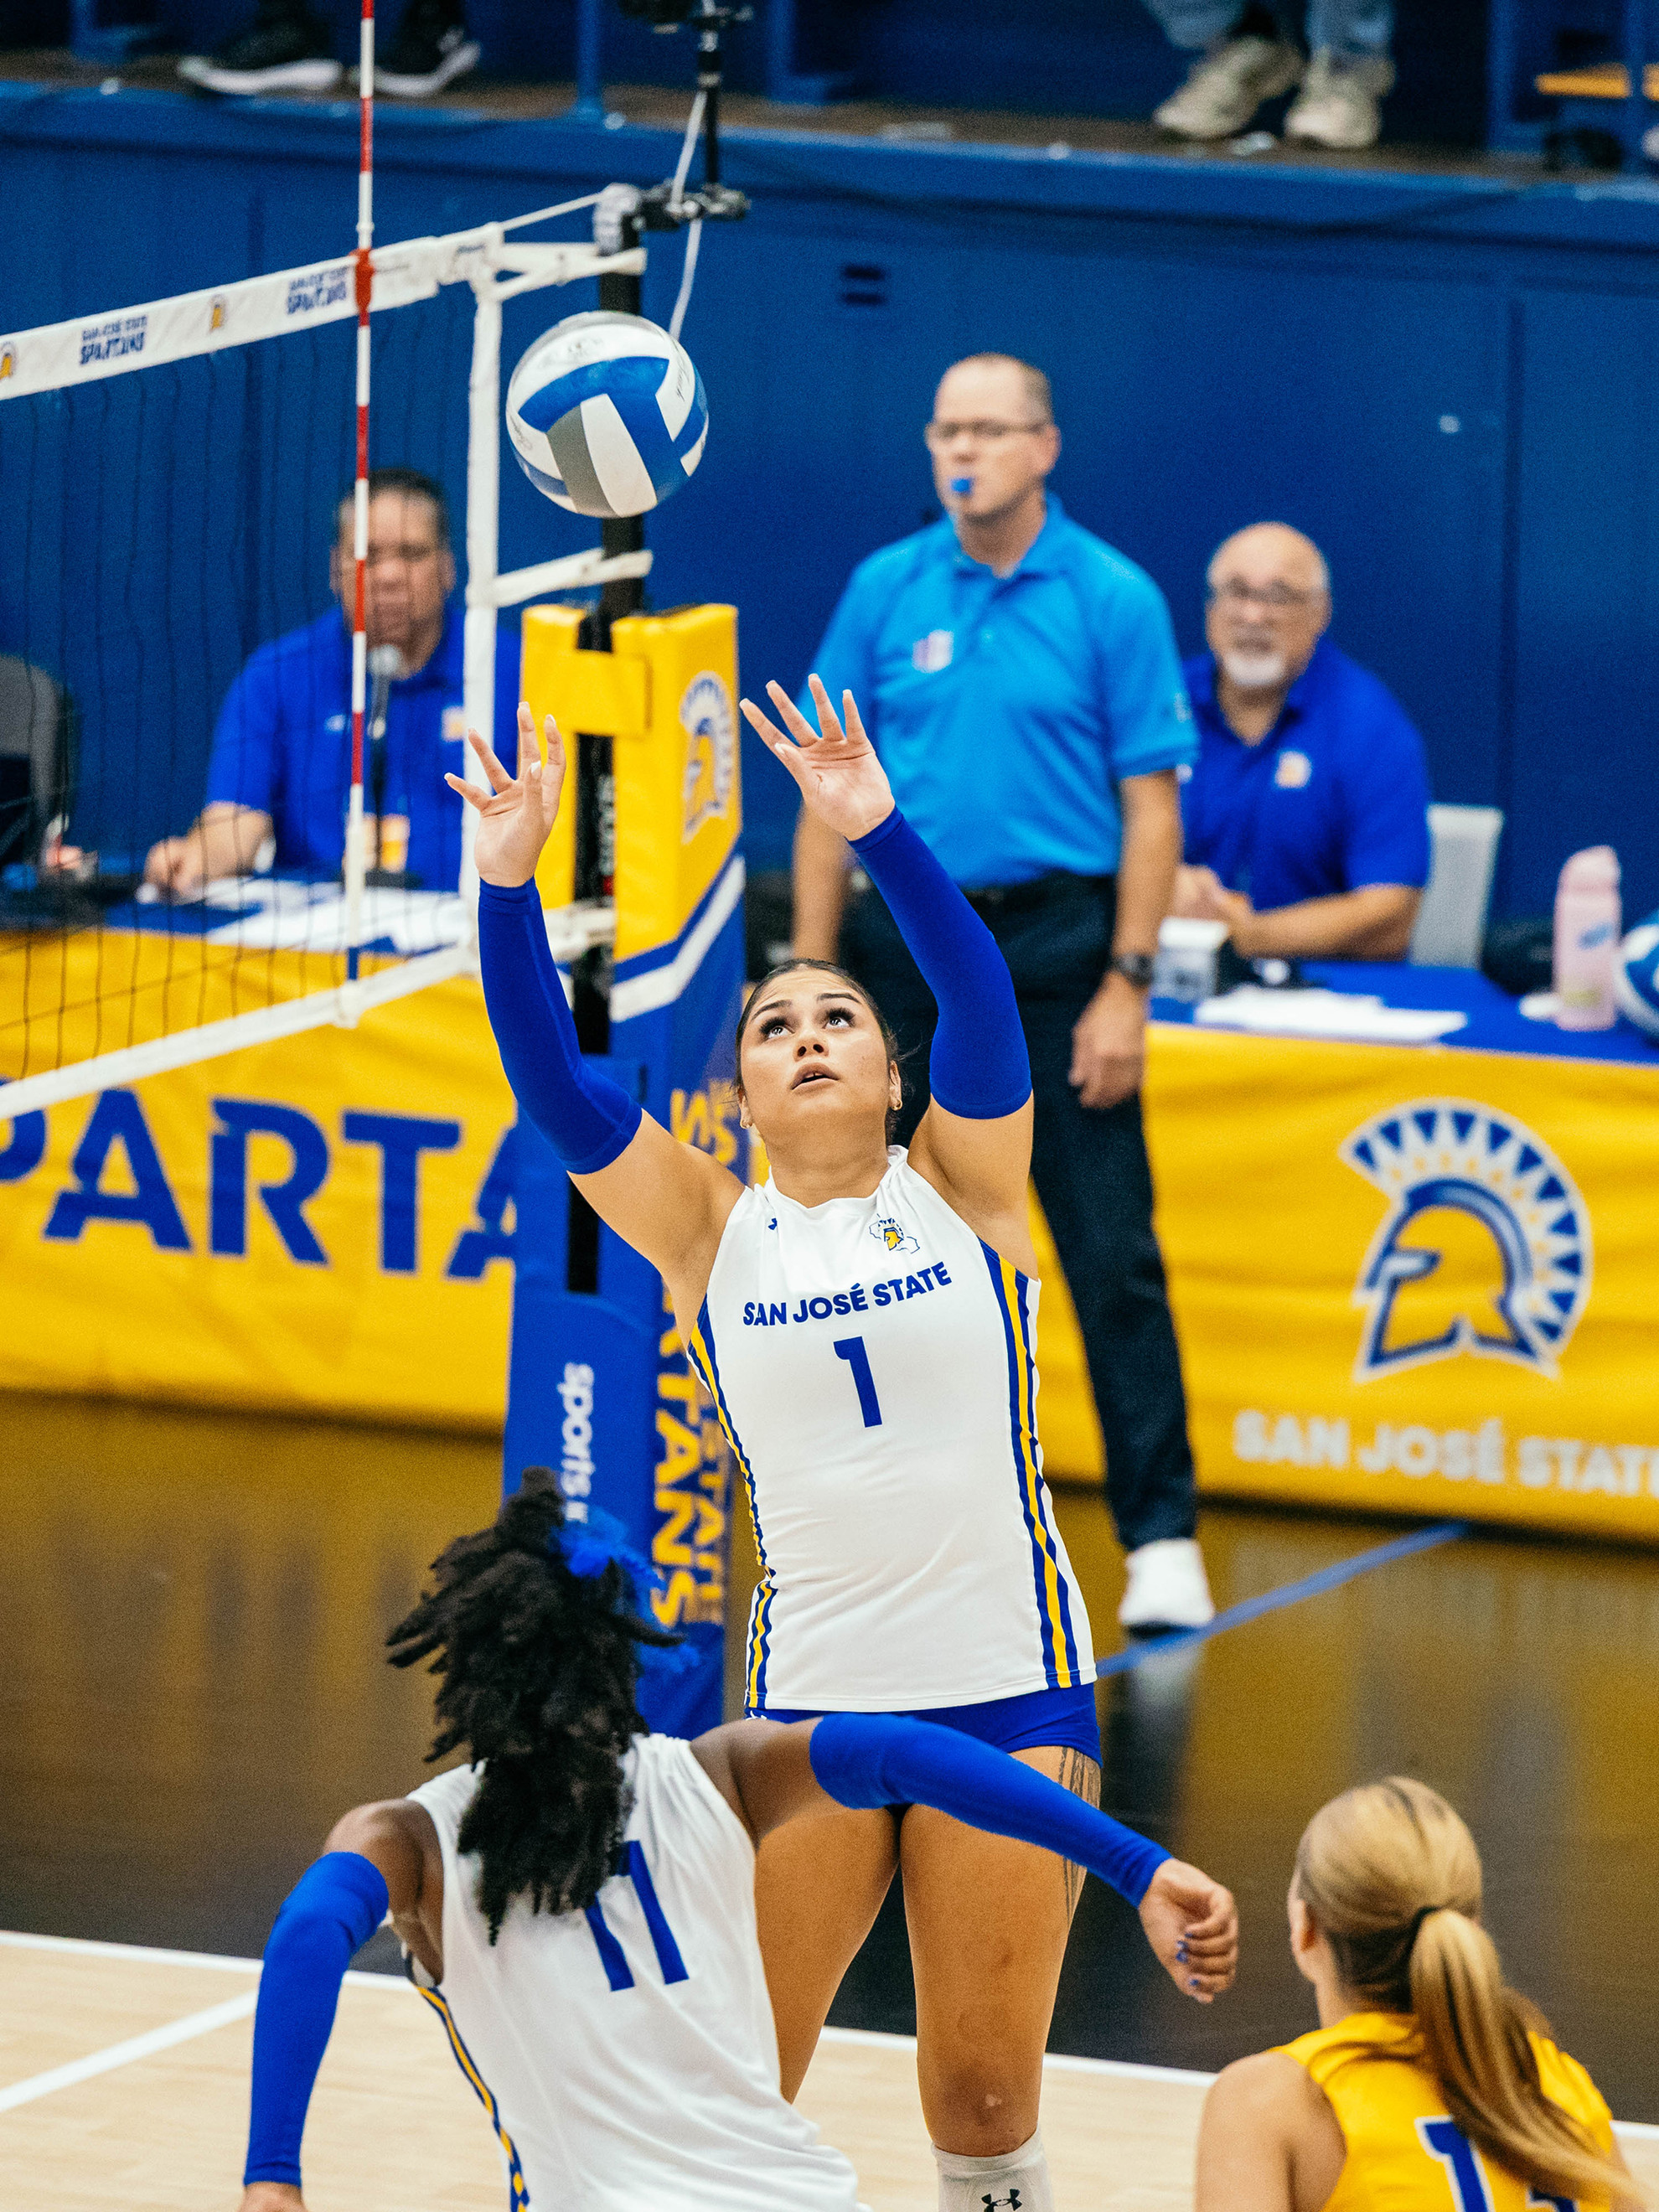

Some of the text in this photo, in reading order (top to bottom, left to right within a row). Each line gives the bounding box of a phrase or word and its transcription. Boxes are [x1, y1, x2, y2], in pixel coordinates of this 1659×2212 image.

[742, 1261, 953, 1326] SAN JOSÉ STATE
[833, 1336, 883, 1428] 1
[1234, 1410, 1350, 1468] SAN
[1358, 1416, 1506, 1483] JOSÉ
[587, 1840, 690, 1992] 11
